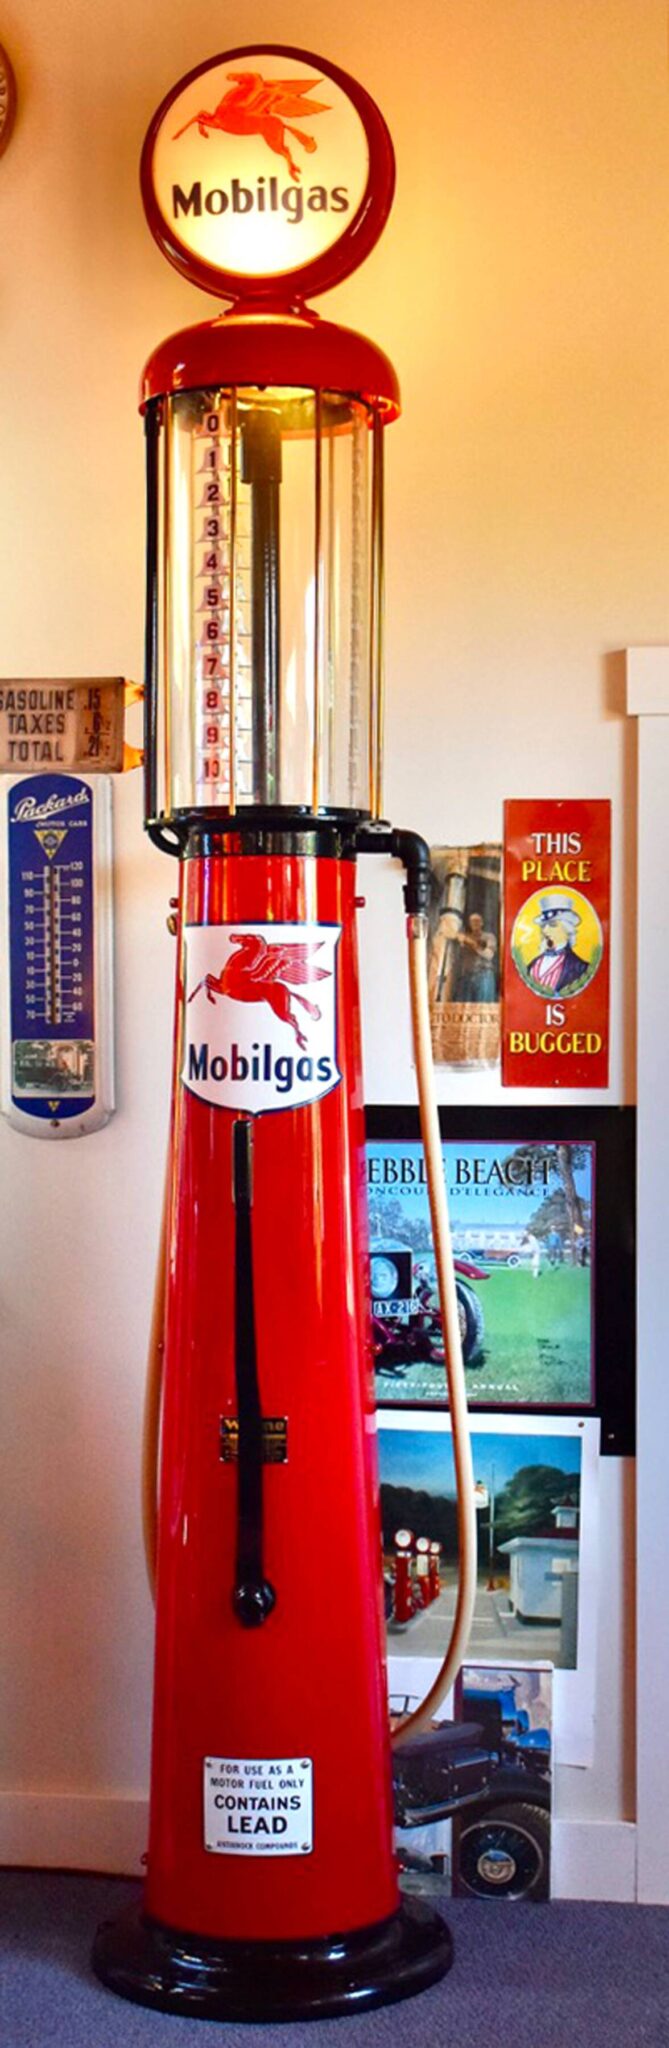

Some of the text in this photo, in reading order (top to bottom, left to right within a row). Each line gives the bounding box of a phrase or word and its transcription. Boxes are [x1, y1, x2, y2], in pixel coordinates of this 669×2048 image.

[172, 176, 350, 224] Mobilgas
[207, 414, 219, 432] 0
[209, 451, 215, 468] 1
[207, 484, 219, 502] 2
[207, 519, 219, 537] 3
[206, 553, 218, 569] 4
[207, 588, 218, 606] 5
[206, 622, 219, 639] 6
[207, 657, 218, 675] 7
[206, 691, 218, 709] 8
[8, 713, 66, 735] TAXES
[206, 726, 218, 744] 9
[8, 740, 64, 762] TOTAL
[203, 760, 220, 779] 10
[10, 787, 90, 823] Packard
[531, 832, 582, 855] THIS
[521, 859, 592, 883] PLACE
[545, 1004, 566, 1026] IS
[509, 1031, 602, 1054] BUGGED
[188, 1043, 333, 1093] Mobilgas
[367, 1157, 549, 1186] EBBL BEACH
[220, 1763, 294, 1776] FOR USE AS A
[210, 1777, 305, 1790] MOTOR FUEL ONLY
[214, 1794, 301, 1811] CONTAINS
[227, 1815, 288, 1834] LEAD
